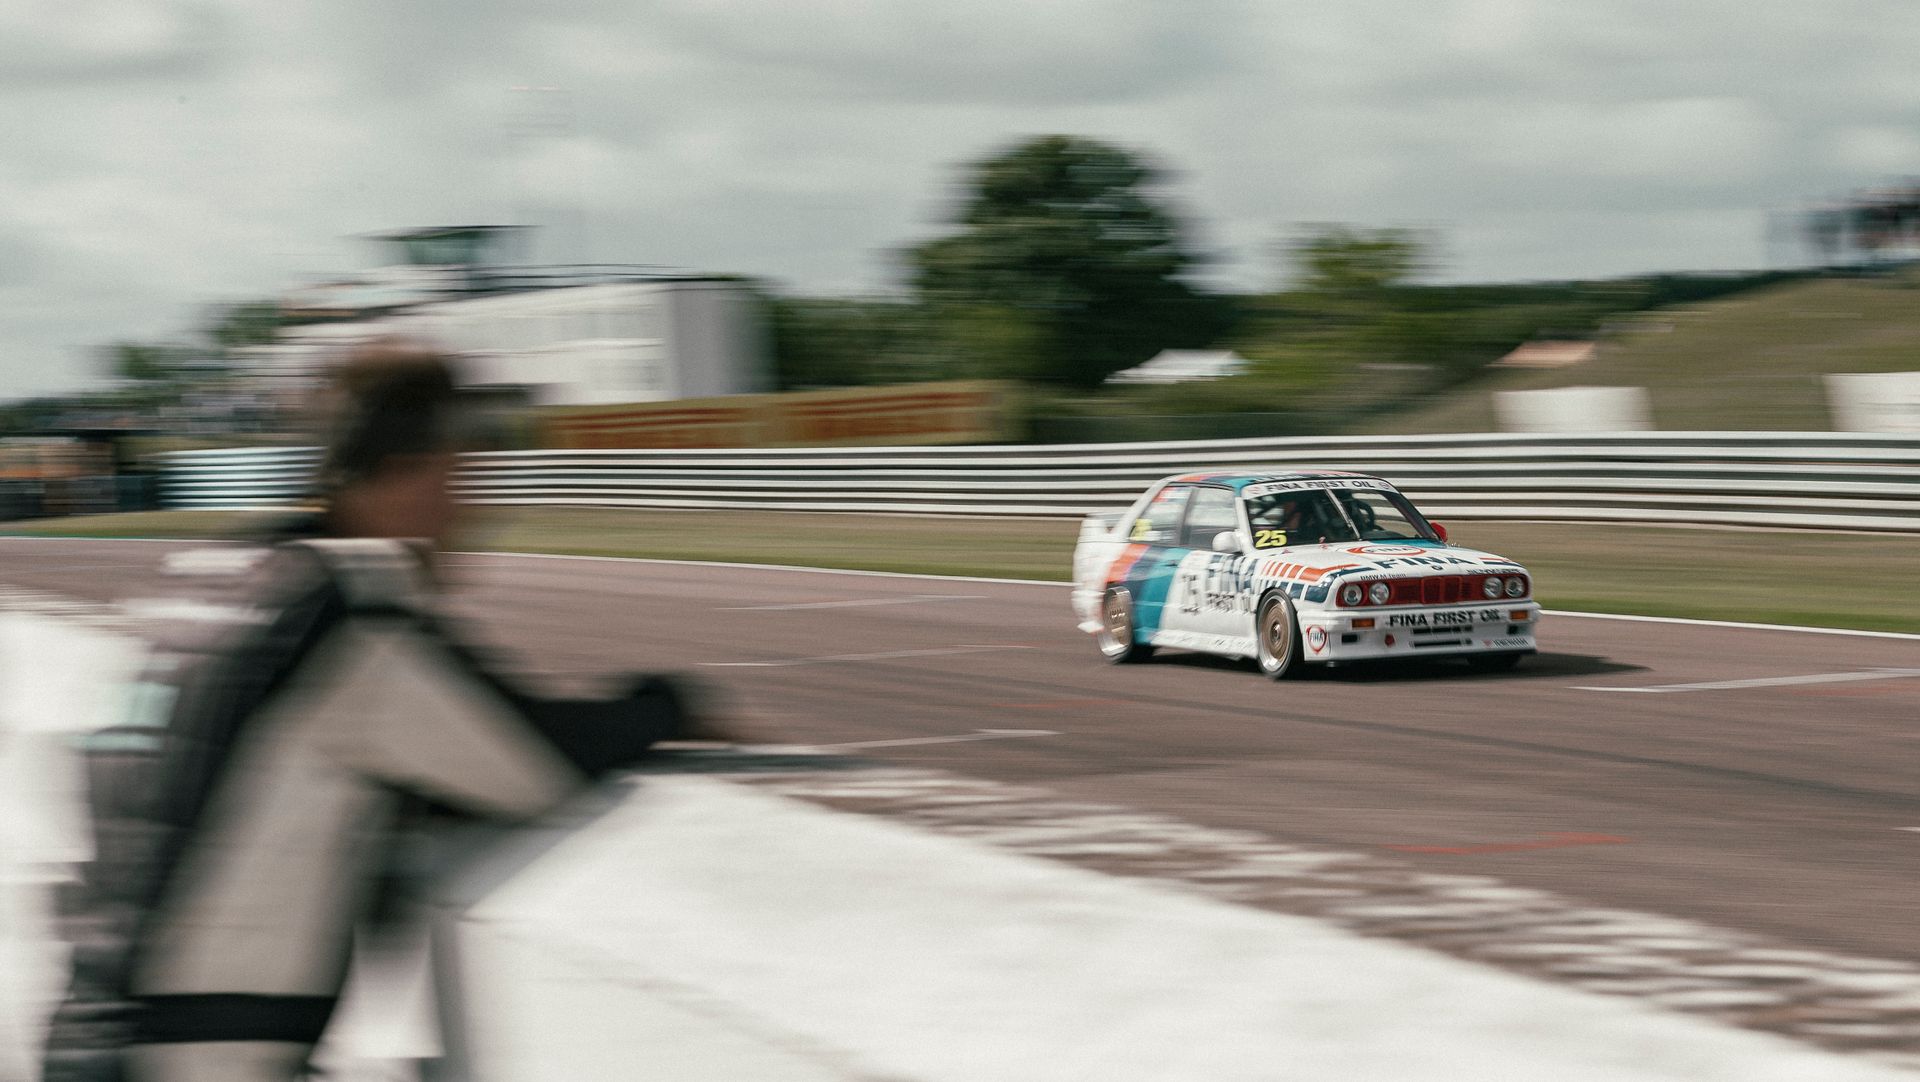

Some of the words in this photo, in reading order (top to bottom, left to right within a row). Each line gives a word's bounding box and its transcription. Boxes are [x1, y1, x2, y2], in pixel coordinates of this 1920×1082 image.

[1266, 482, 1302, 492] FINA
[1352, 480, 1375, 488] OIL
[1255, 529, 1287, 548] 25
[1373, 557, 1476, 569] FINA
[1389, 614, 1428, 627] FINA
[1432, 610, 1475, 625] FIRST
